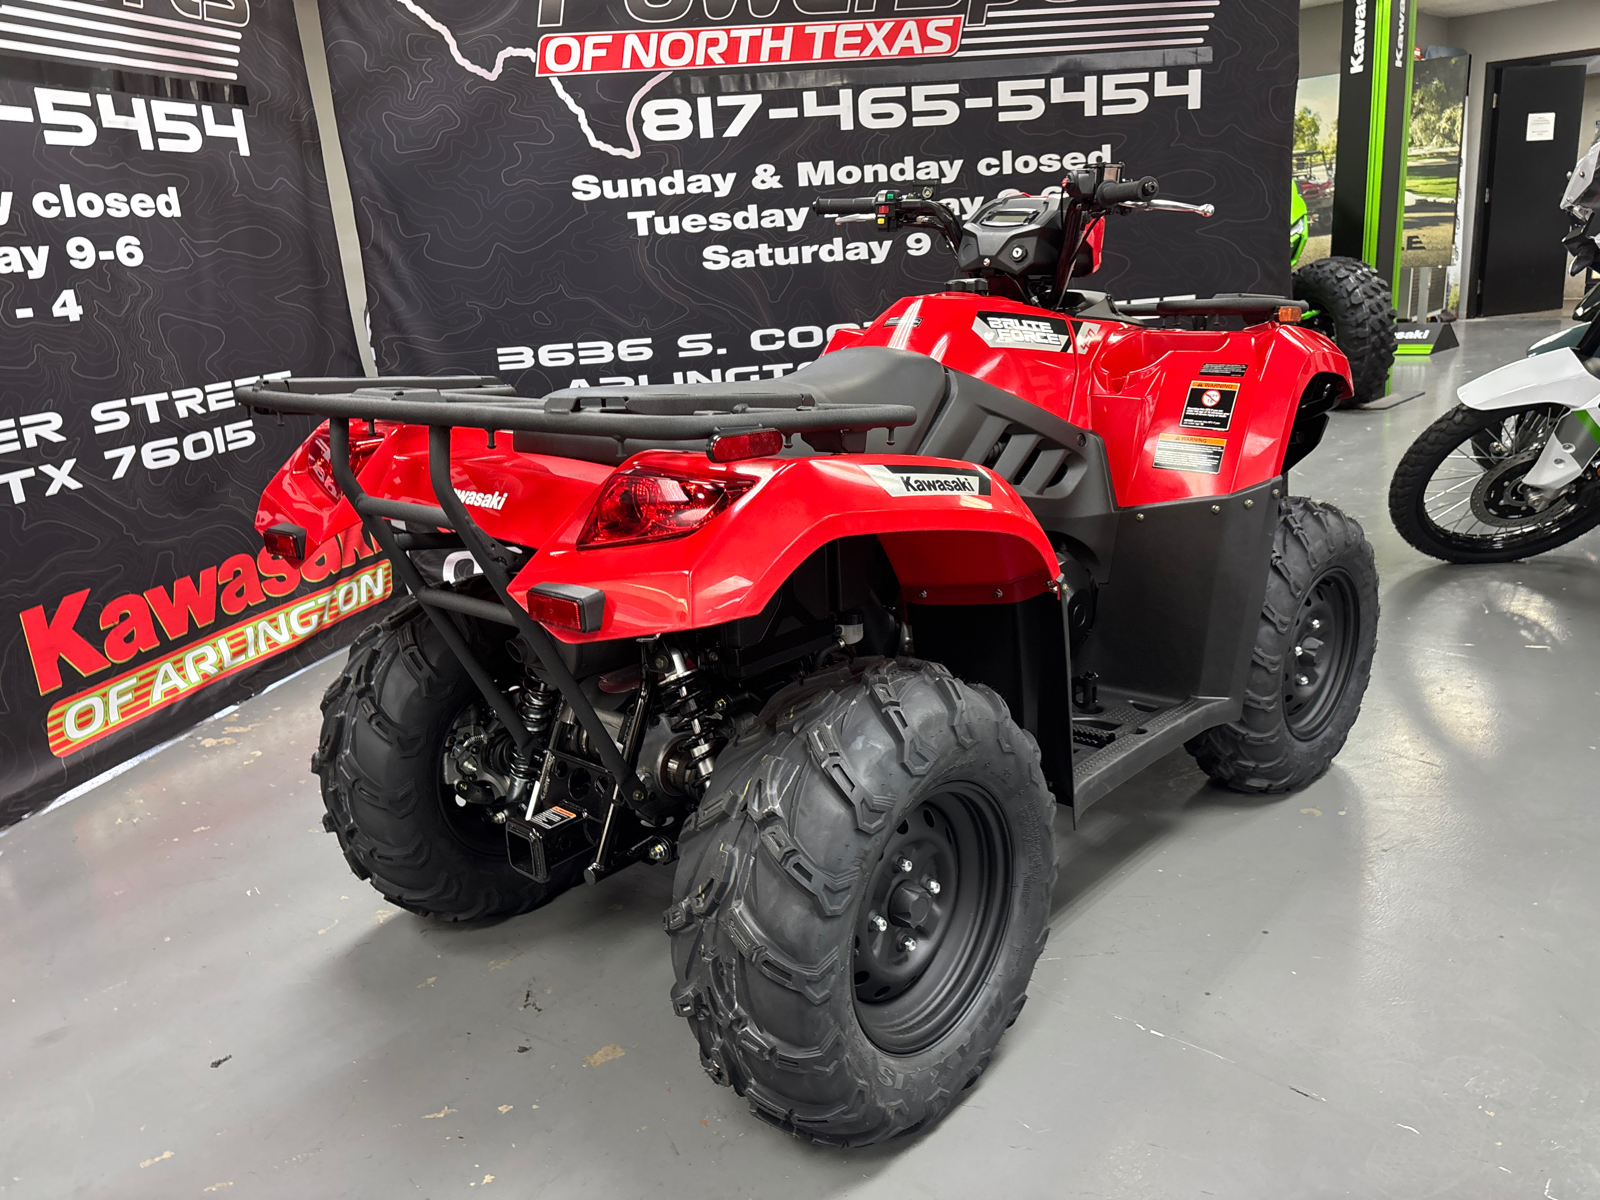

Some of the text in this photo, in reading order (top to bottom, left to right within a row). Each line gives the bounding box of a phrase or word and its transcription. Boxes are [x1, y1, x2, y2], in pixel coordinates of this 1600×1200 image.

[545, 19, 954, 72] OF NORTH TEXAS
[642, 70, 1201, 141] 817-465-5454
[571, 144, 1111, 201] Sunday & Monday closed
[32, 184, 182, 218] closed
[627, 204, 809, 236] Tuesday
[66, 235, 144, 270] 9-6
[702, 233, 931, 270] Saturday 9
[52, 289, 84, 322] 4
[987, 317, 1054, 333] BRUTE
[996, 329, 1061, 346] FORCE
[497, 337, 653, 370] 3636
[677, 333, 727, 358] S.
[90, 370, 291, 434] STRE
[0, 419, 256, 505] TX 76015
[453, 488, 508, 510] wasaki
[900, 476, 975, 492] Kawasaki
[19, 523, 383, 696] Kawasak
[65, 567, 384, 740] OF ARLINGTON
